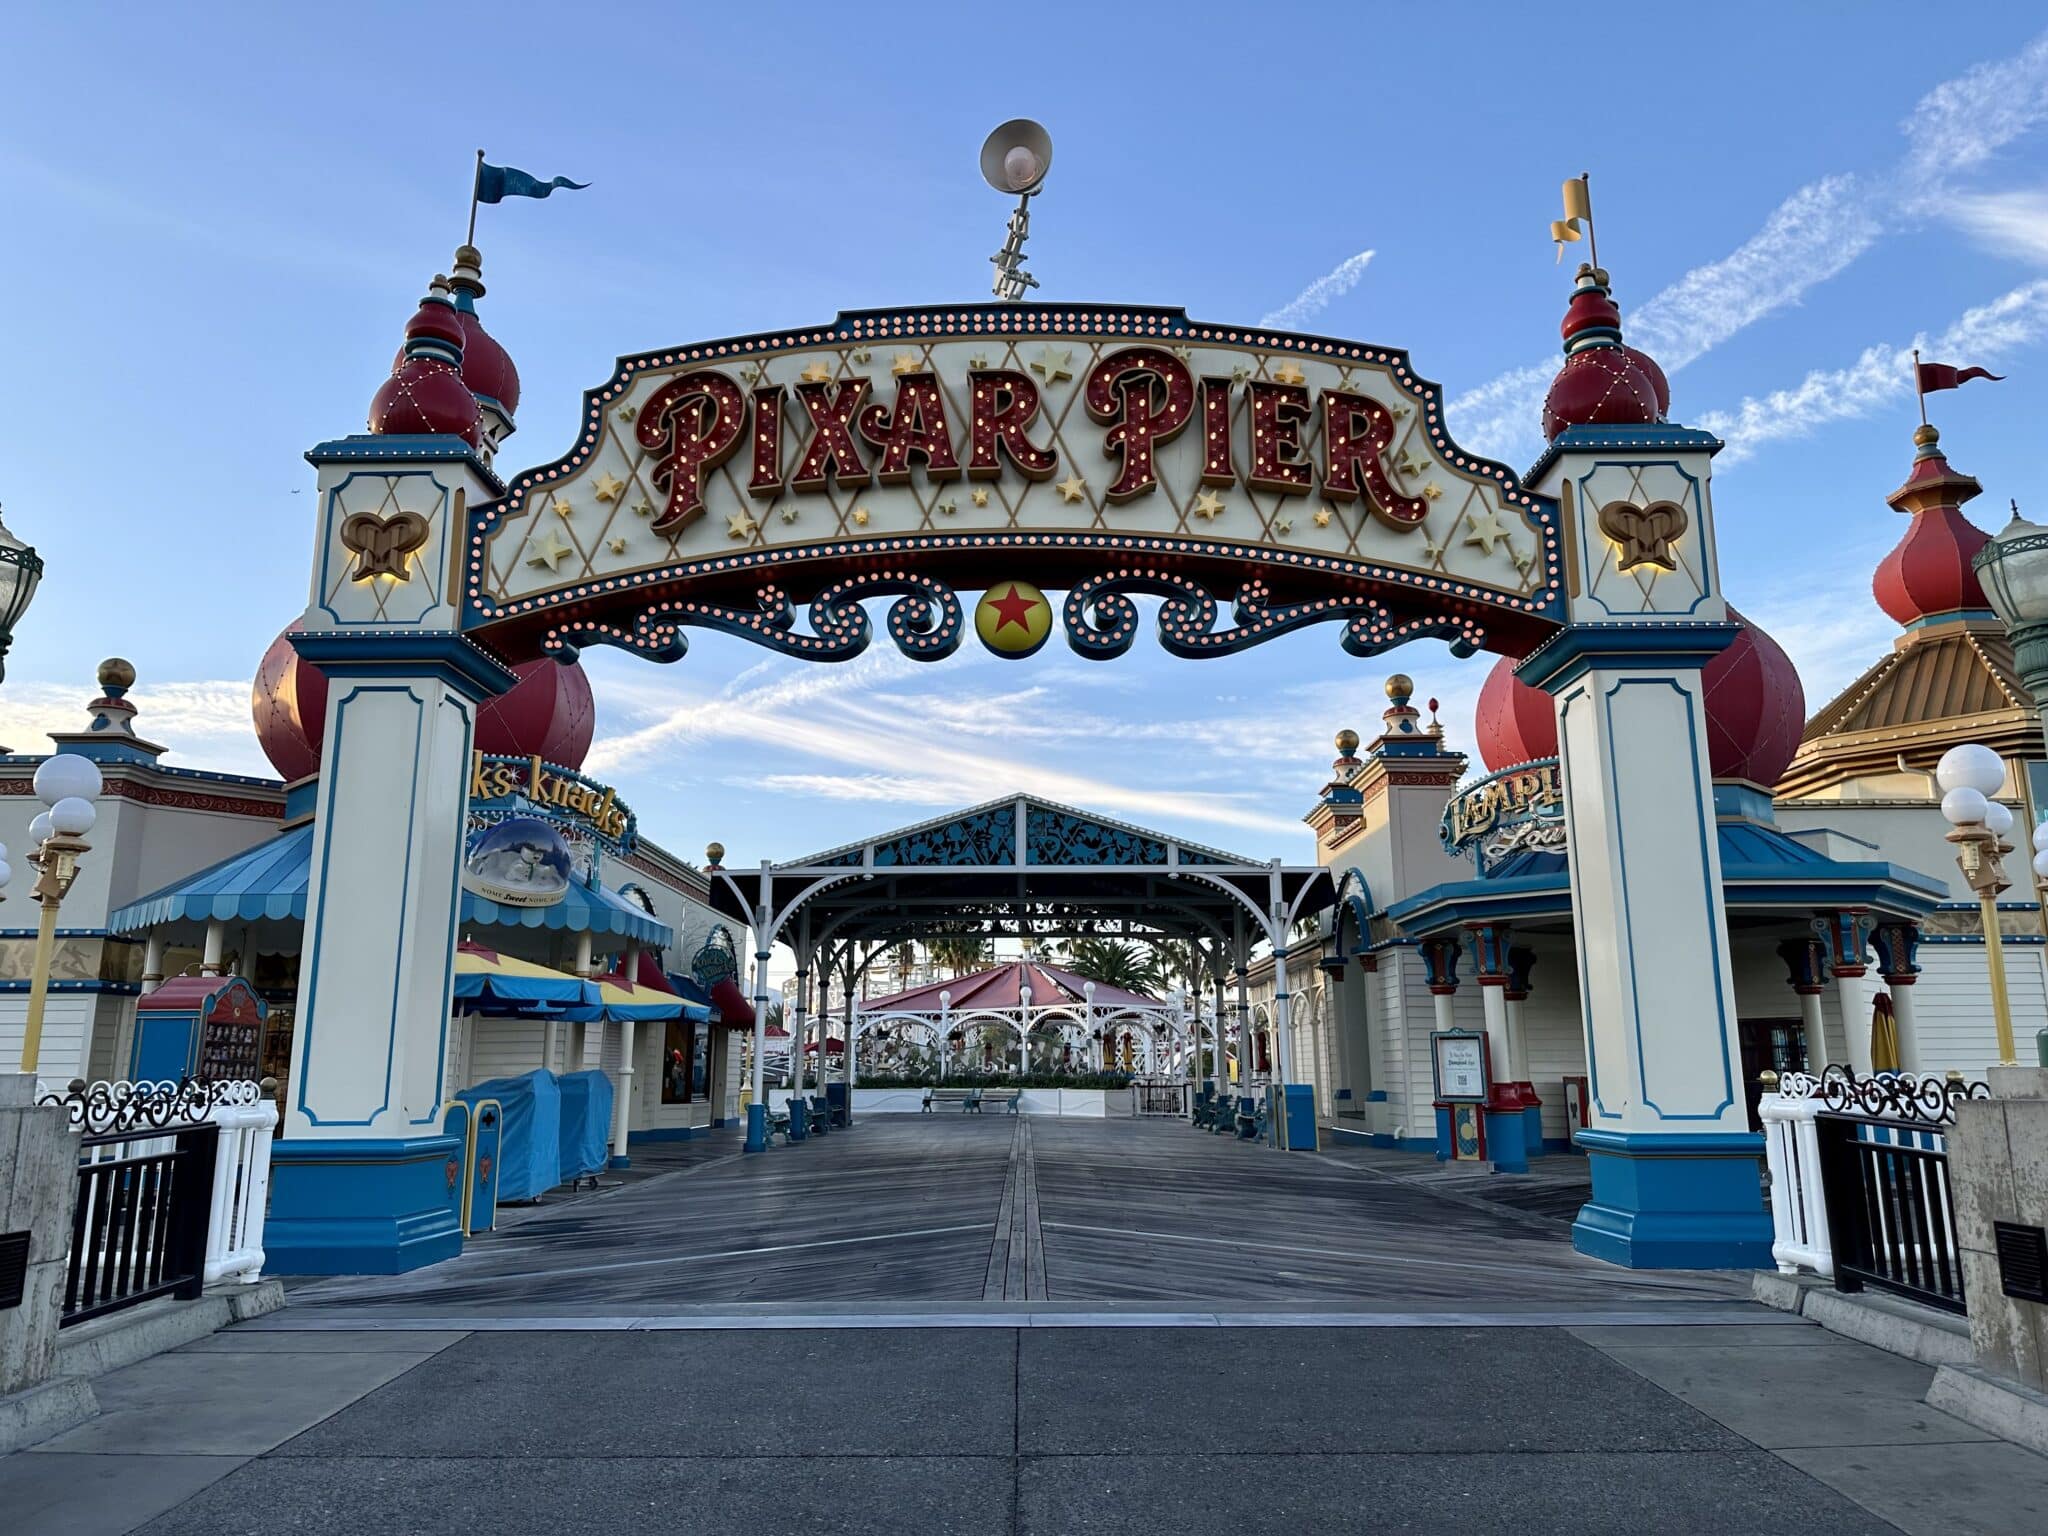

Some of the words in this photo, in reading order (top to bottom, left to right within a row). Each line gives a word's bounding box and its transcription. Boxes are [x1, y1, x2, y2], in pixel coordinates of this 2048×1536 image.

[634, 368, 1058, 536] PIXAR
[1085, 346, 1428, 533] PIER
[1450, 766, 1563, 846] LAMPL
[1486, 820, 1567, 858] Lou
